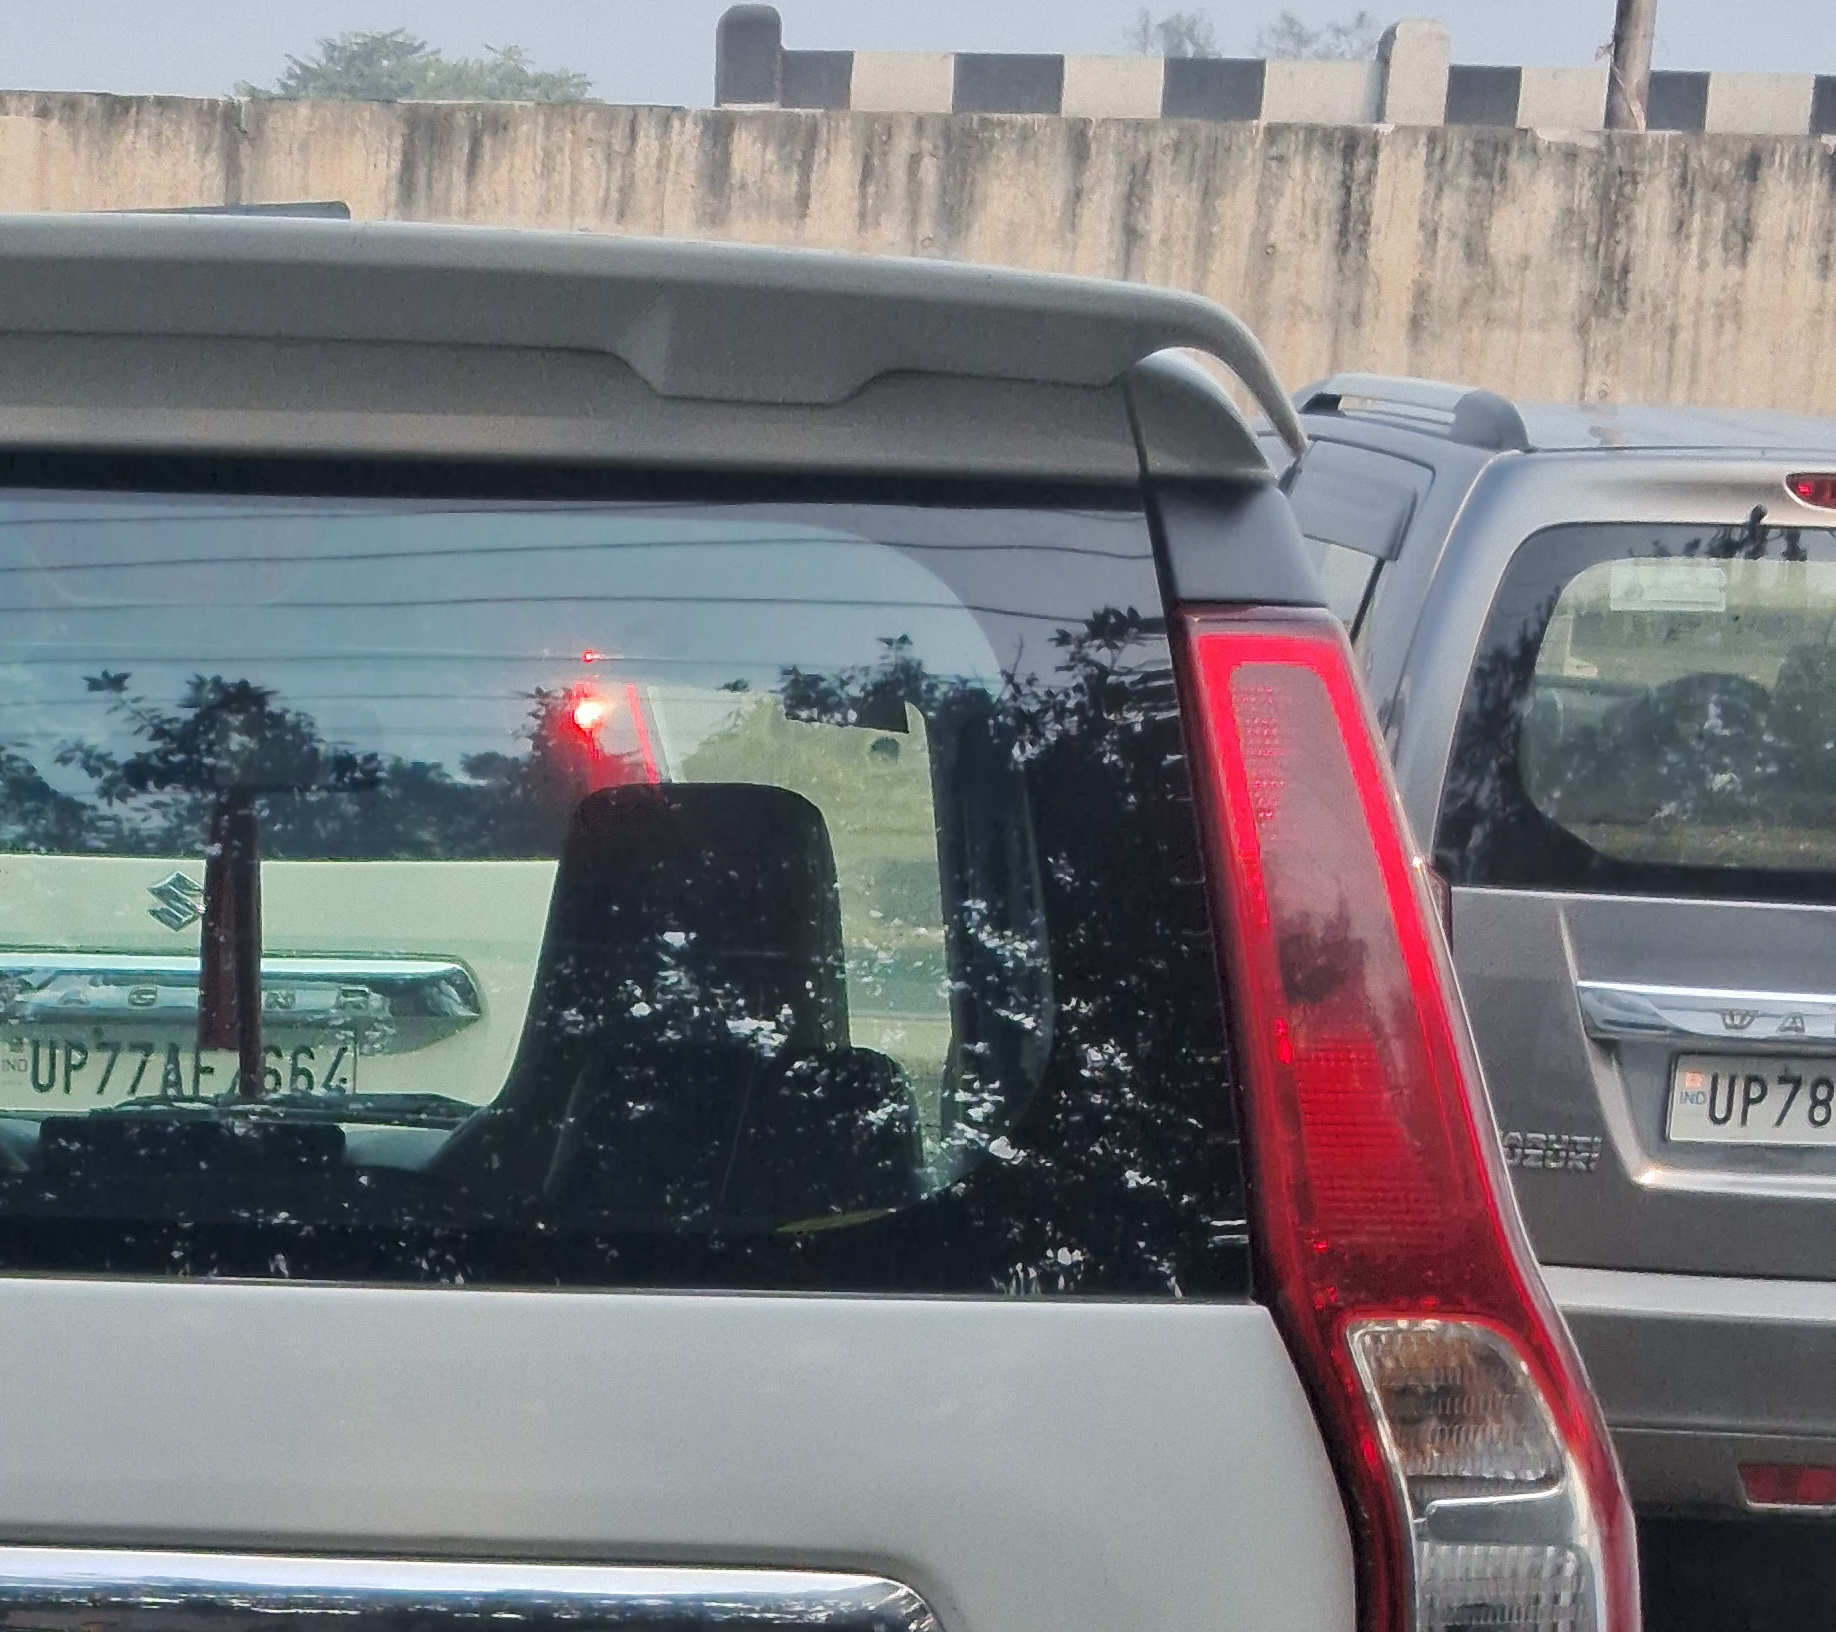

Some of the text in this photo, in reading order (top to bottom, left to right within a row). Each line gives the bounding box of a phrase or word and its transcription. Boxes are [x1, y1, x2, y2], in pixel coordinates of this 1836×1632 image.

[1679, 1091, 1706, 1106] IND
[1707, 1071, 1835, 1128] UP78
[1501, 1131, 1604, 1152] ARUTI
[1504, 1147, 1601, 1172] UZUKI
